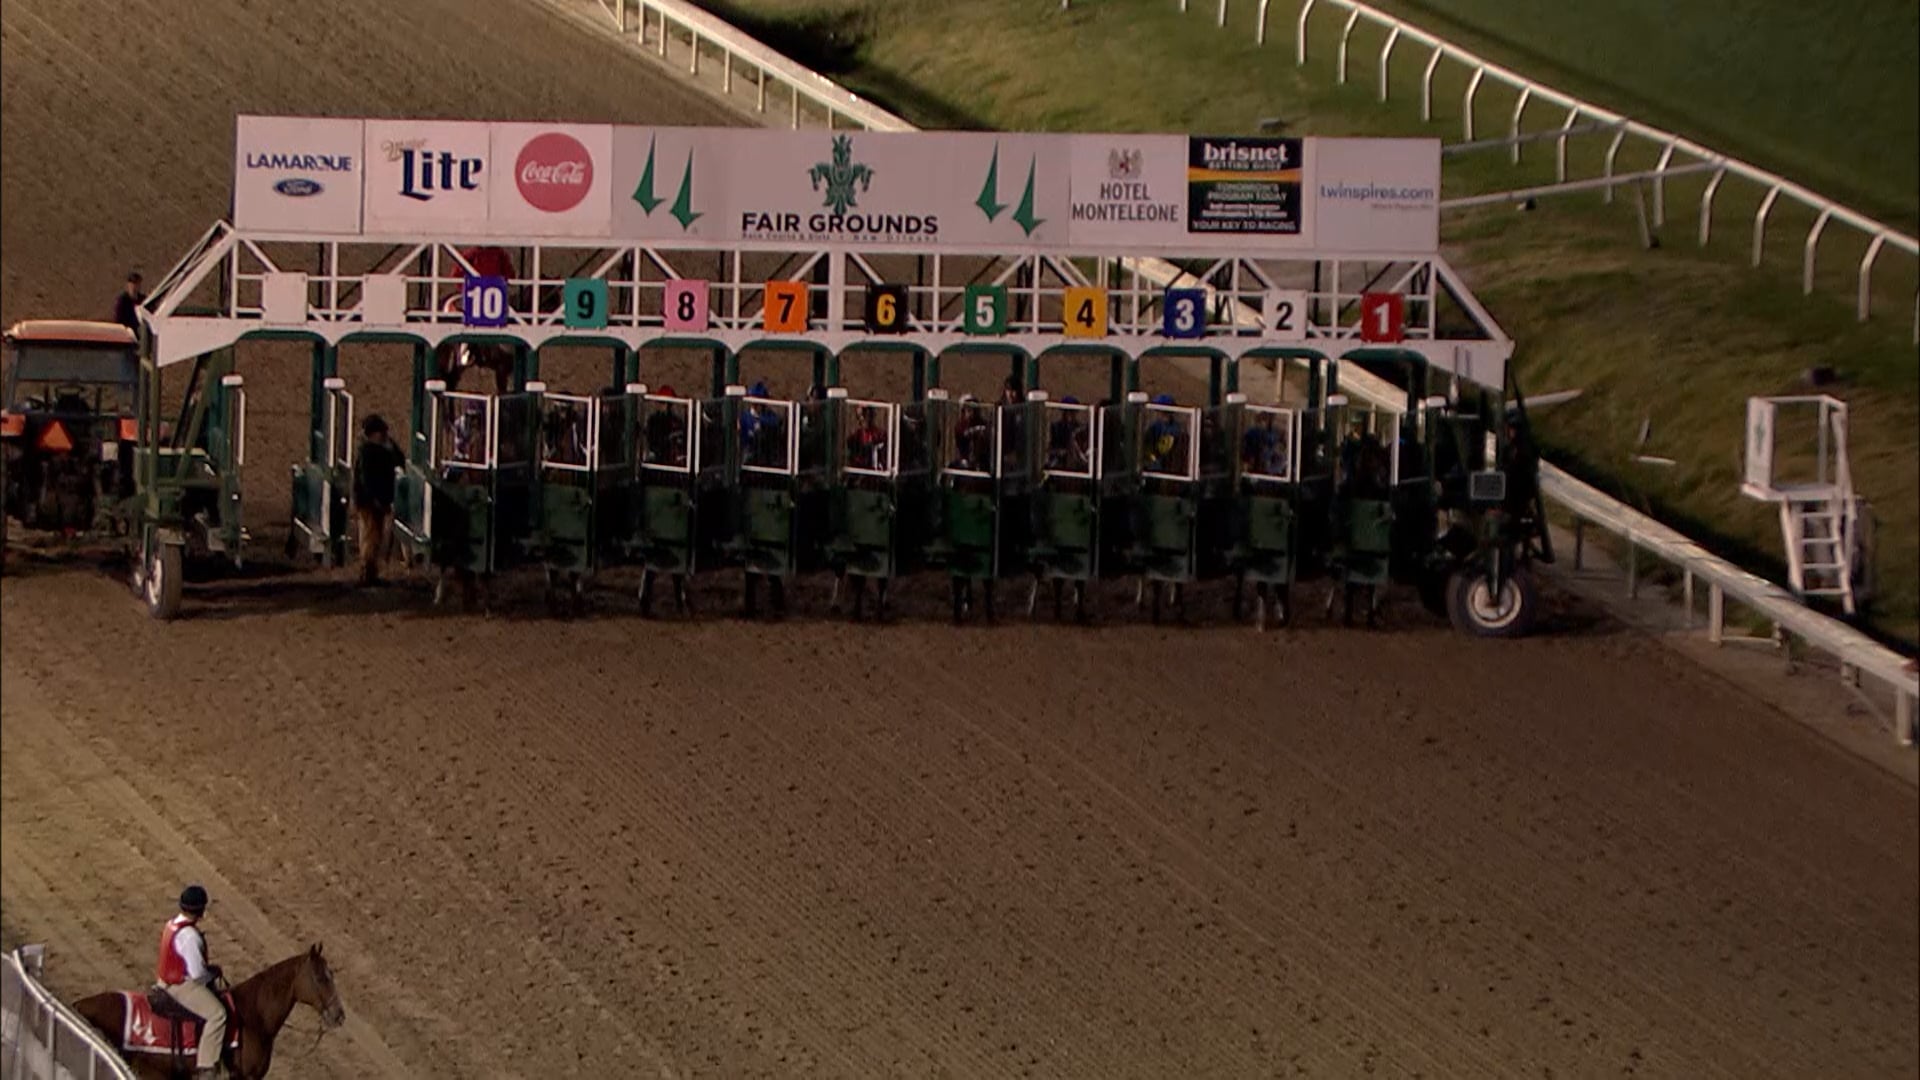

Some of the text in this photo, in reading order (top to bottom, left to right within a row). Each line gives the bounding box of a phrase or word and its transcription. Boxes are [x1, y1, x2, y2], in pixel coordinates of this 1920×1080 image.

[246, 152, 352, 172] LAMARQUE
[1203, 141, 1289, 162] brisnet
[398, 148, 483, 202] Lite
[1100, 182, 1150, 201] HOTEL
[1320, 181, 1434, 201] twinspires.com
[742, 212, 938, 235] FAIR GROUNDS
[1072, 204, 1179, 223] MONTELEONE
[467, 286, 501, 320] 10
[577, 290, 595, 320] 9
[678, 291, 696, 322] 8
[777, 292, 796, 324] 7
[876, 293, 897, 326] 6
[976, 295, 995, 328] 5
[1076, 298, 1096, 328] 4
[1175, 299, 1195, 331] 3
[1276, 302, 1293, 331] 2
[1374, 302, 1390, 335] 1
